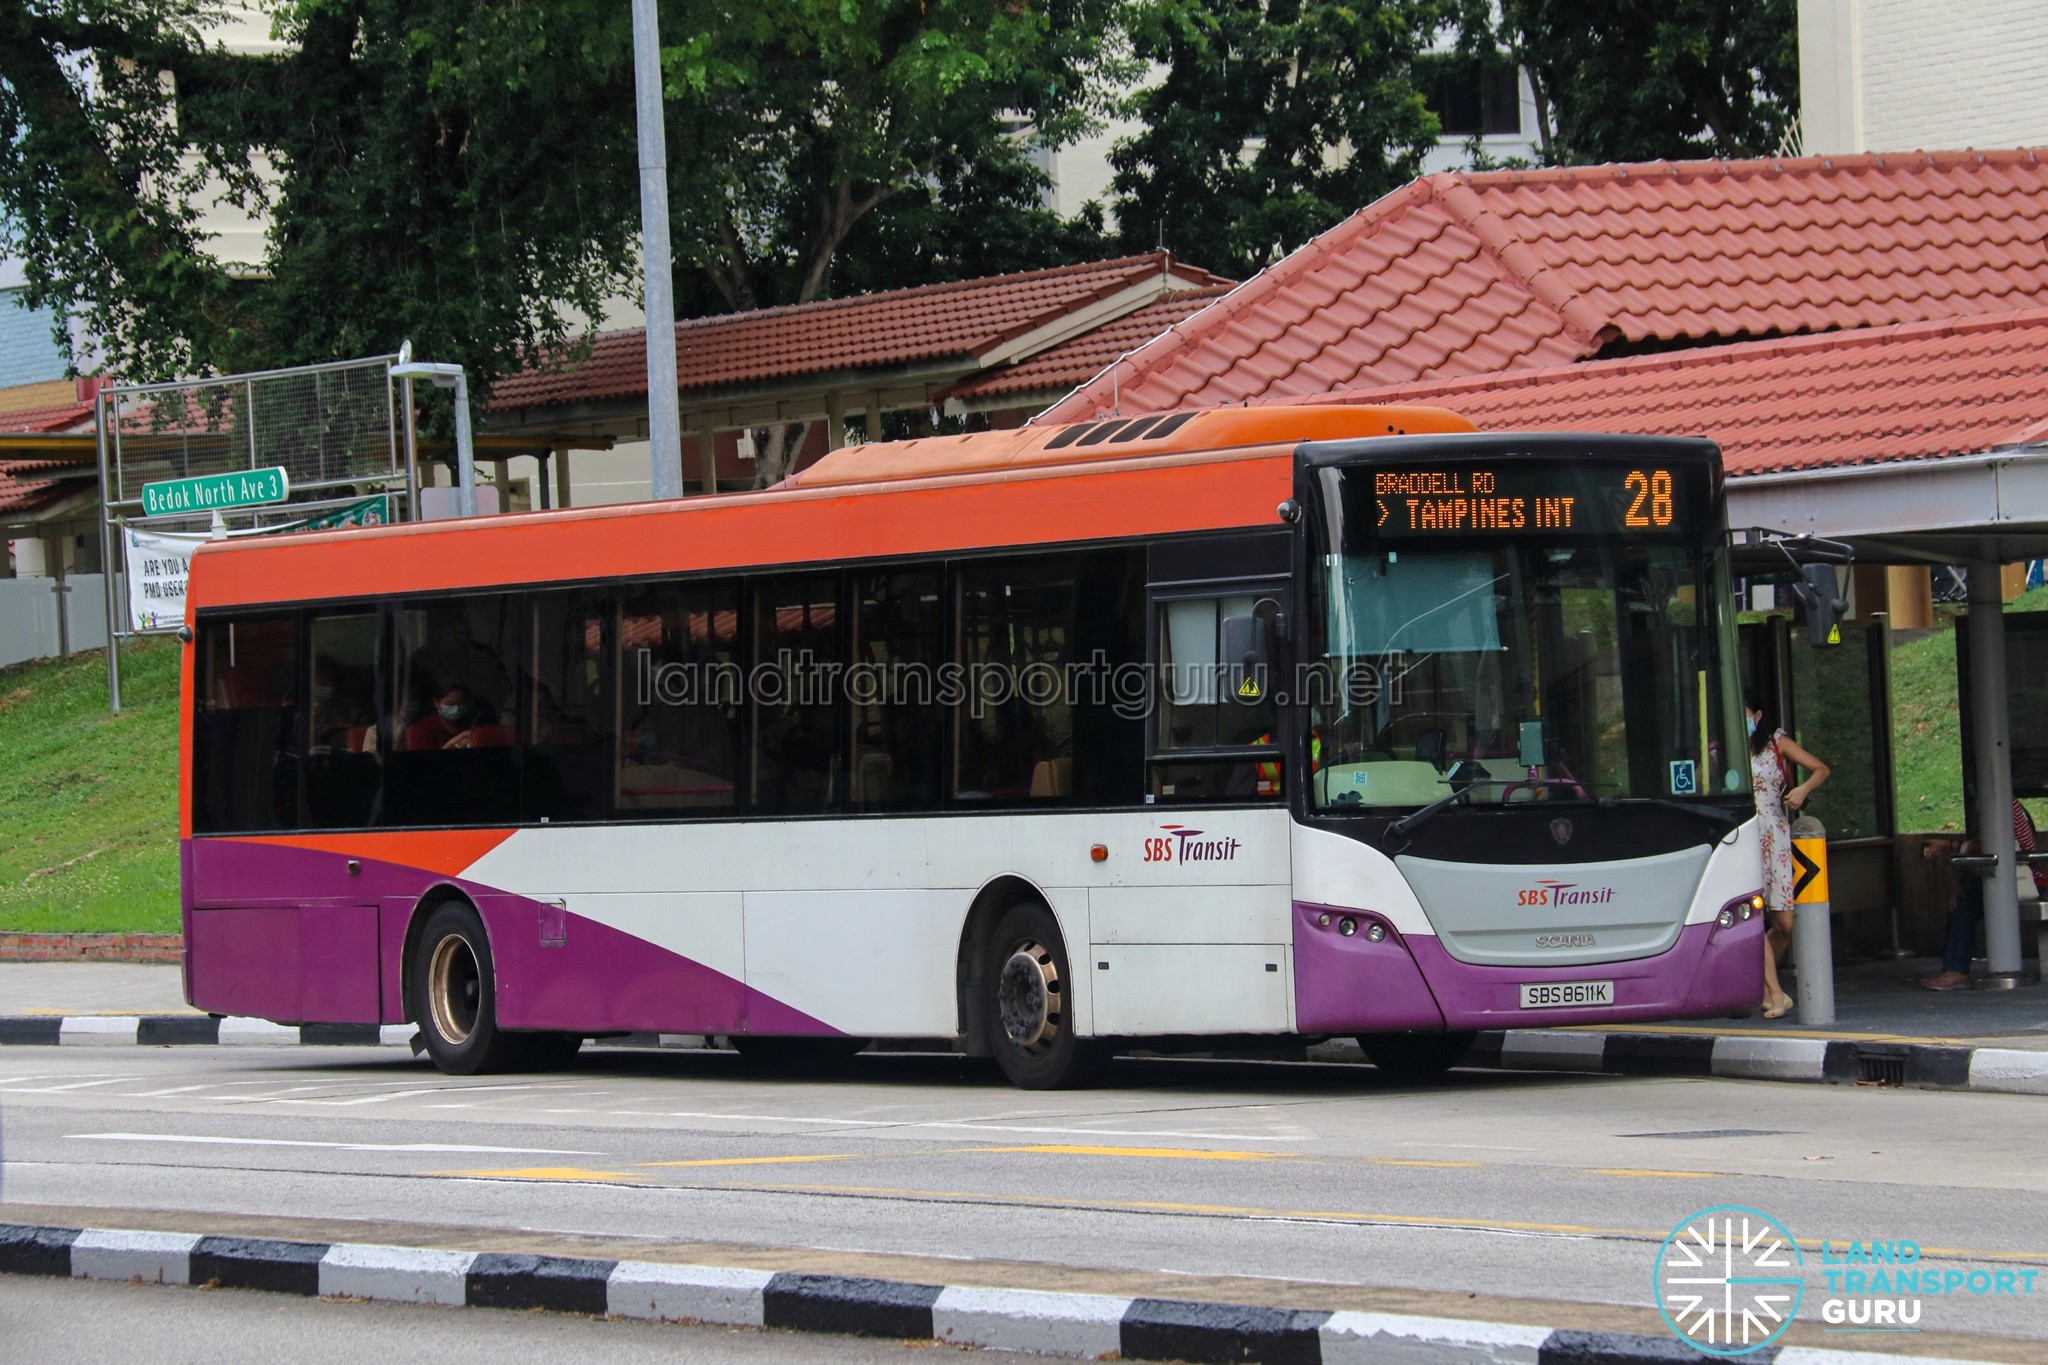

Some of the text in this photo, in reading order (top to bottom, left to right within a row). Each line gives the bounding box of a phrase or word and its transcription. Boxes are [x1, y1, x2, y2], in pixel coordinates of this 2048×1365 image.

[148, 474, 278, 511] Bedok North Ave 3
[1376, 472, 1494, 494] BRADDELL RD
[1624, 470, 1672, 526] 28
[1407, 498, 1574, 528] TAMPINES INT
[144, 559, 160, 577] ARE
[161, 558, 179, 575] YOU
[143, 582, 161, 599] PMD
[1144, 830, 1242, 866] SBS Transit
[1517, 883, 1617, 909] SBS Transit
[1535, 933, 1597, 949] SCANIA
[1529, 985, 1606, 1004] SBS8611K
